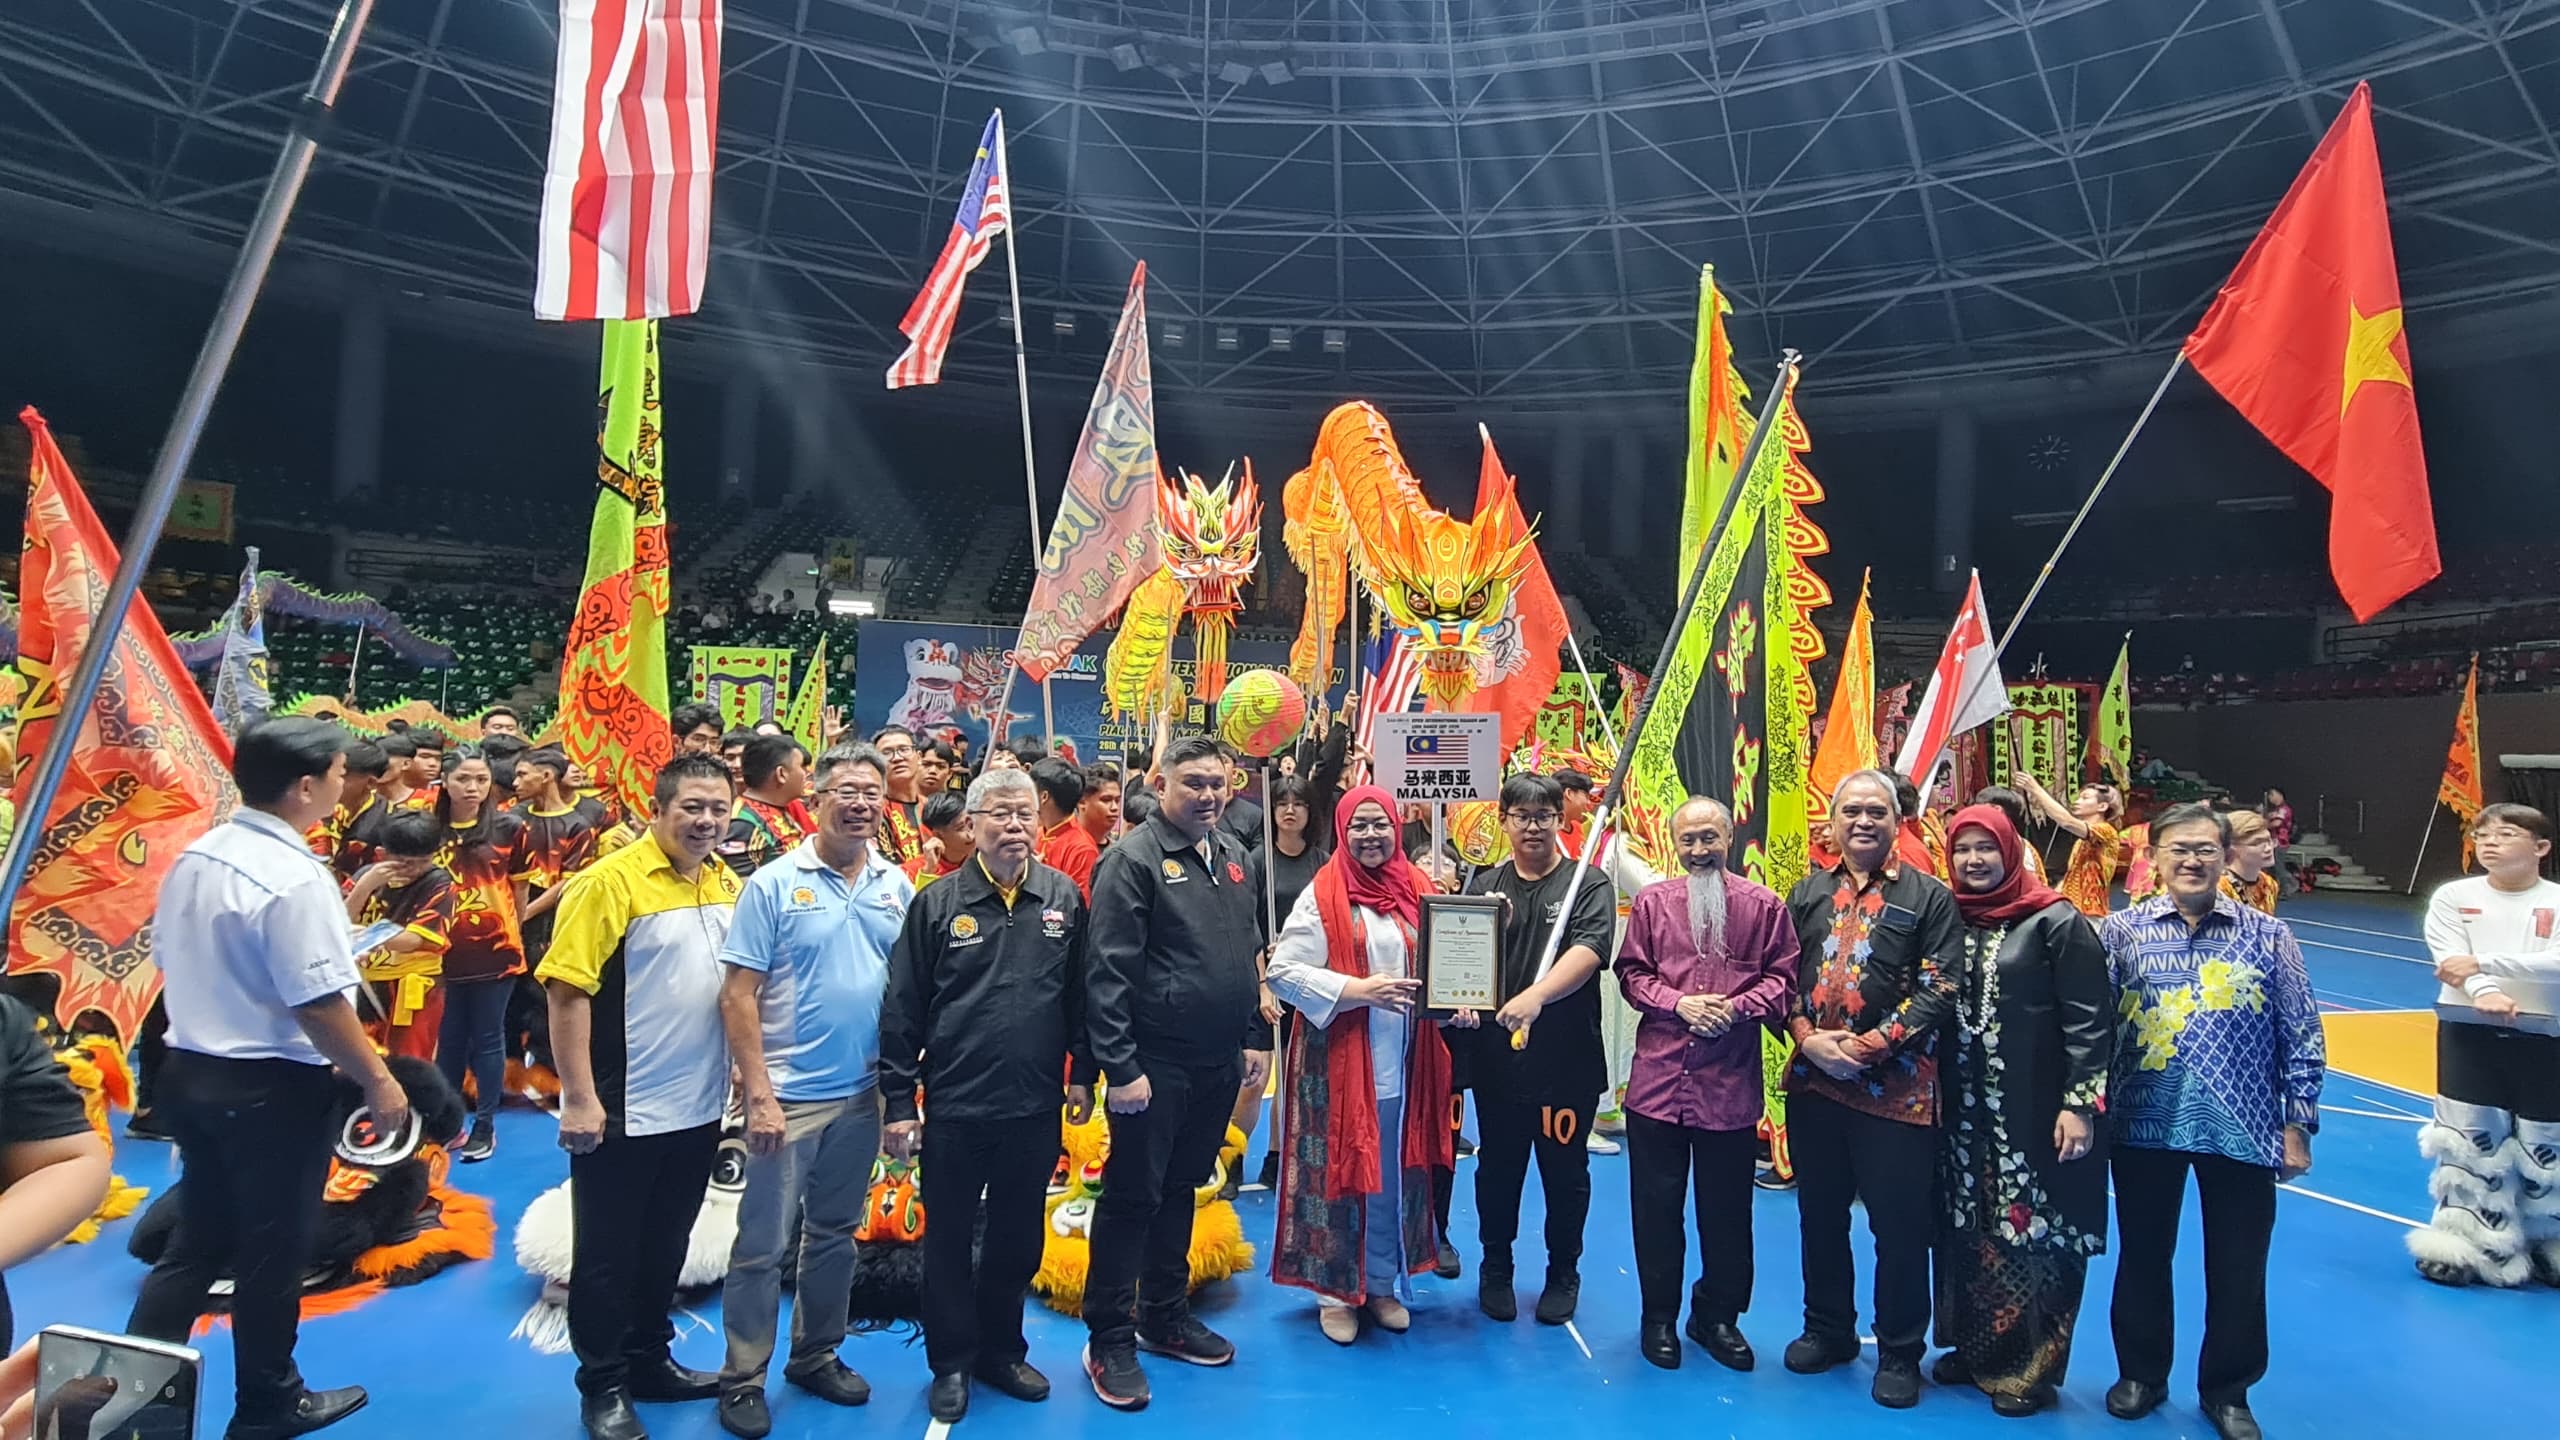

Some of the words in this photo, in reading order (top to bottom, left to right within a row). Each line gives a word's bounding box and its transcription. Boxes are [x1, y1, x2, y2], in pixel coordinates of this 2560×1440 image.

[1404, 769, 1470, 786] 马来西亚
[1396, 787, 1478, 799] MALAYSIA
[1541, 1105, 1577, 1144] 10
